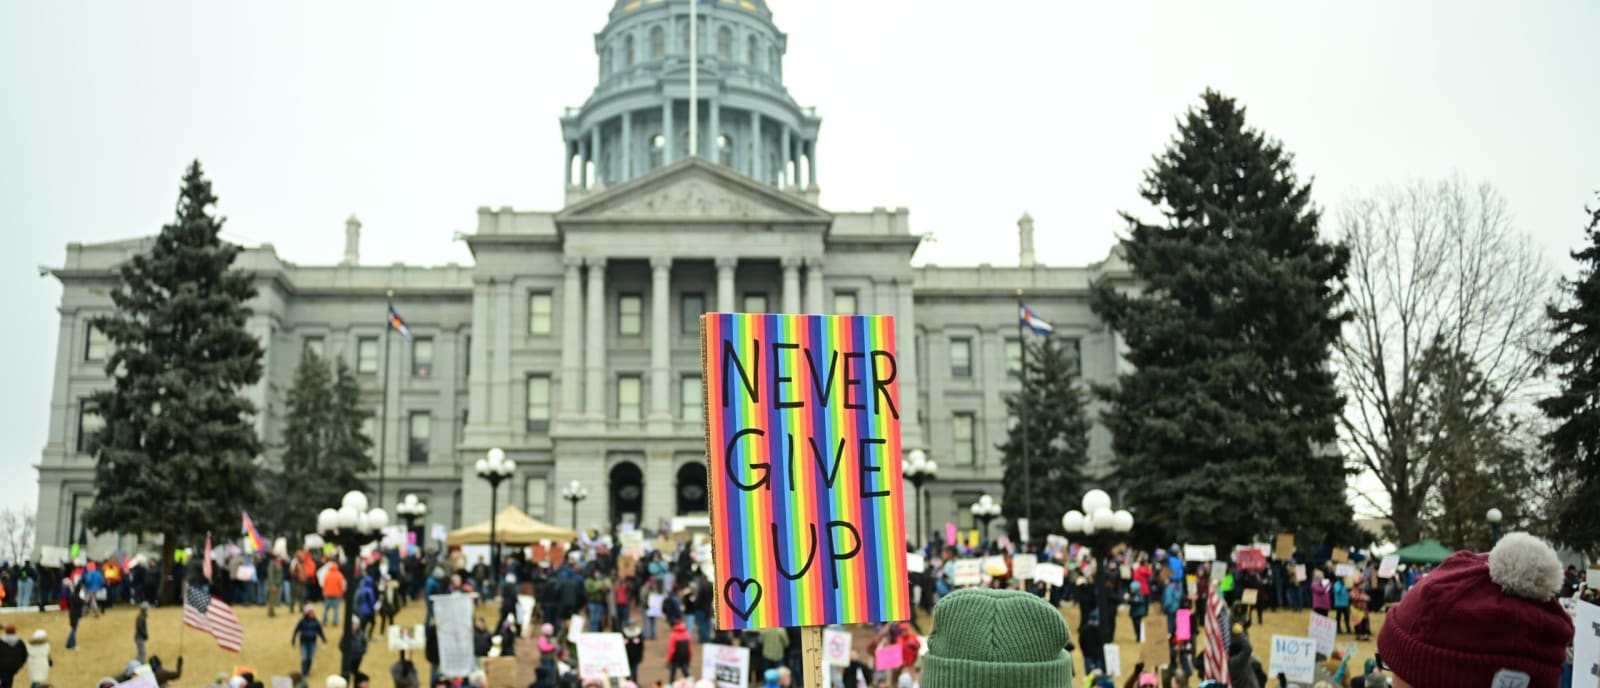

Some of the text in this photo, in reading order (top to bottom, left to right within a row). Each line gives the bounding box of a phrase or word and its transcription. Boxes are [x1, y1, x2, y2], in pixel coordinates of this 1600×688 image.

[722, 339, 899, 420] NEVER
[725, 428, 890, 498] GIVE
[771, 520, 862, 589] UP
[1275, 639, 1312, 657] NOT
